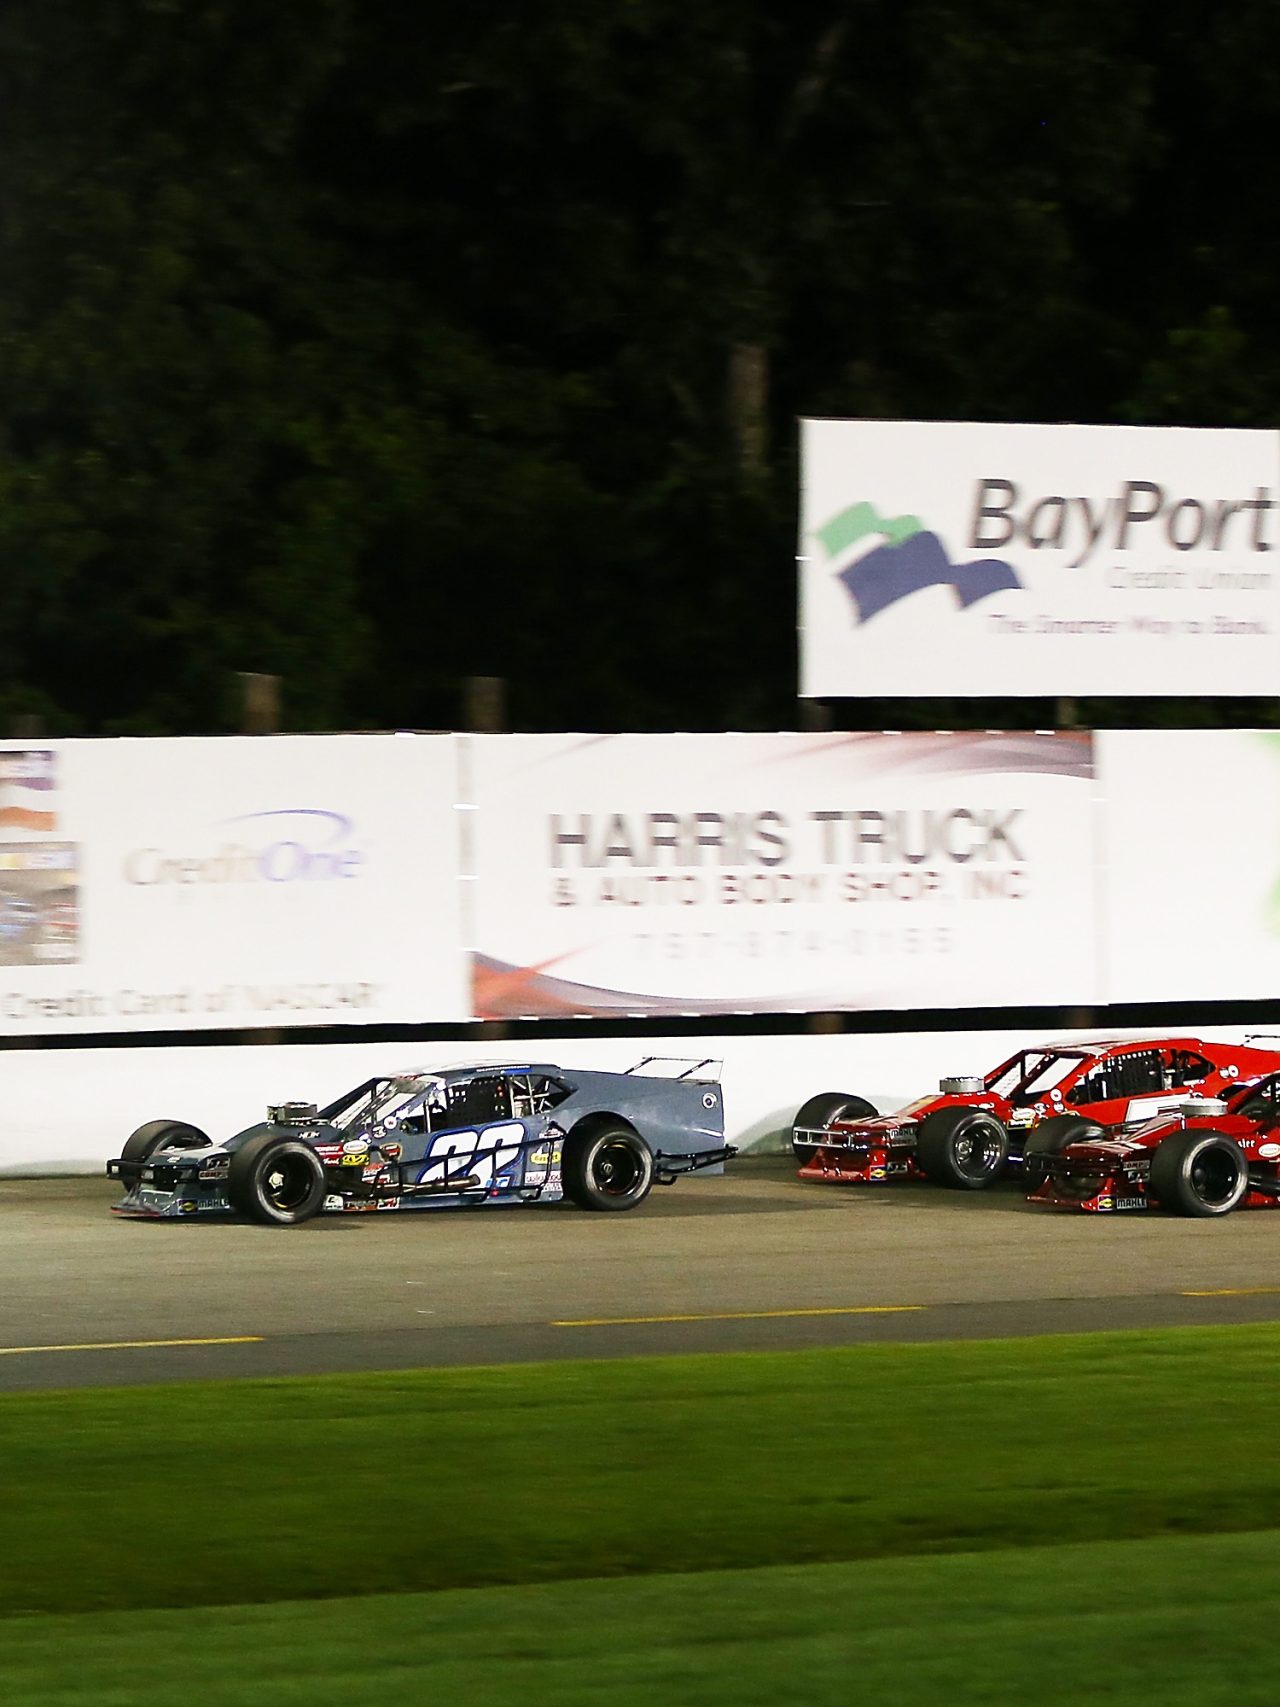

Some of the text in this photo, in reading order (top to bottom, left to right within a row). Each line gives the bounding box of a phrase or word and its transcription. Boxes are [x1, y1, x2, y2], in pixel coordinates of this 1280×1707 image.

[964, 477, 1277, 568] BayPort
[1105, 565, 1184, 590] Credit
[988, 613, 1025, 634] The
[1034, 614, 1118, 635] Smarter
[1132, 616, 1176, 640] Way
[547, 807, 1030, 868] HARRIS TRUCK
[595, 873, 698, 906] AUTO
[717, 872, 829, 905] BODY
[418, 1121, 525, 1190] 22
